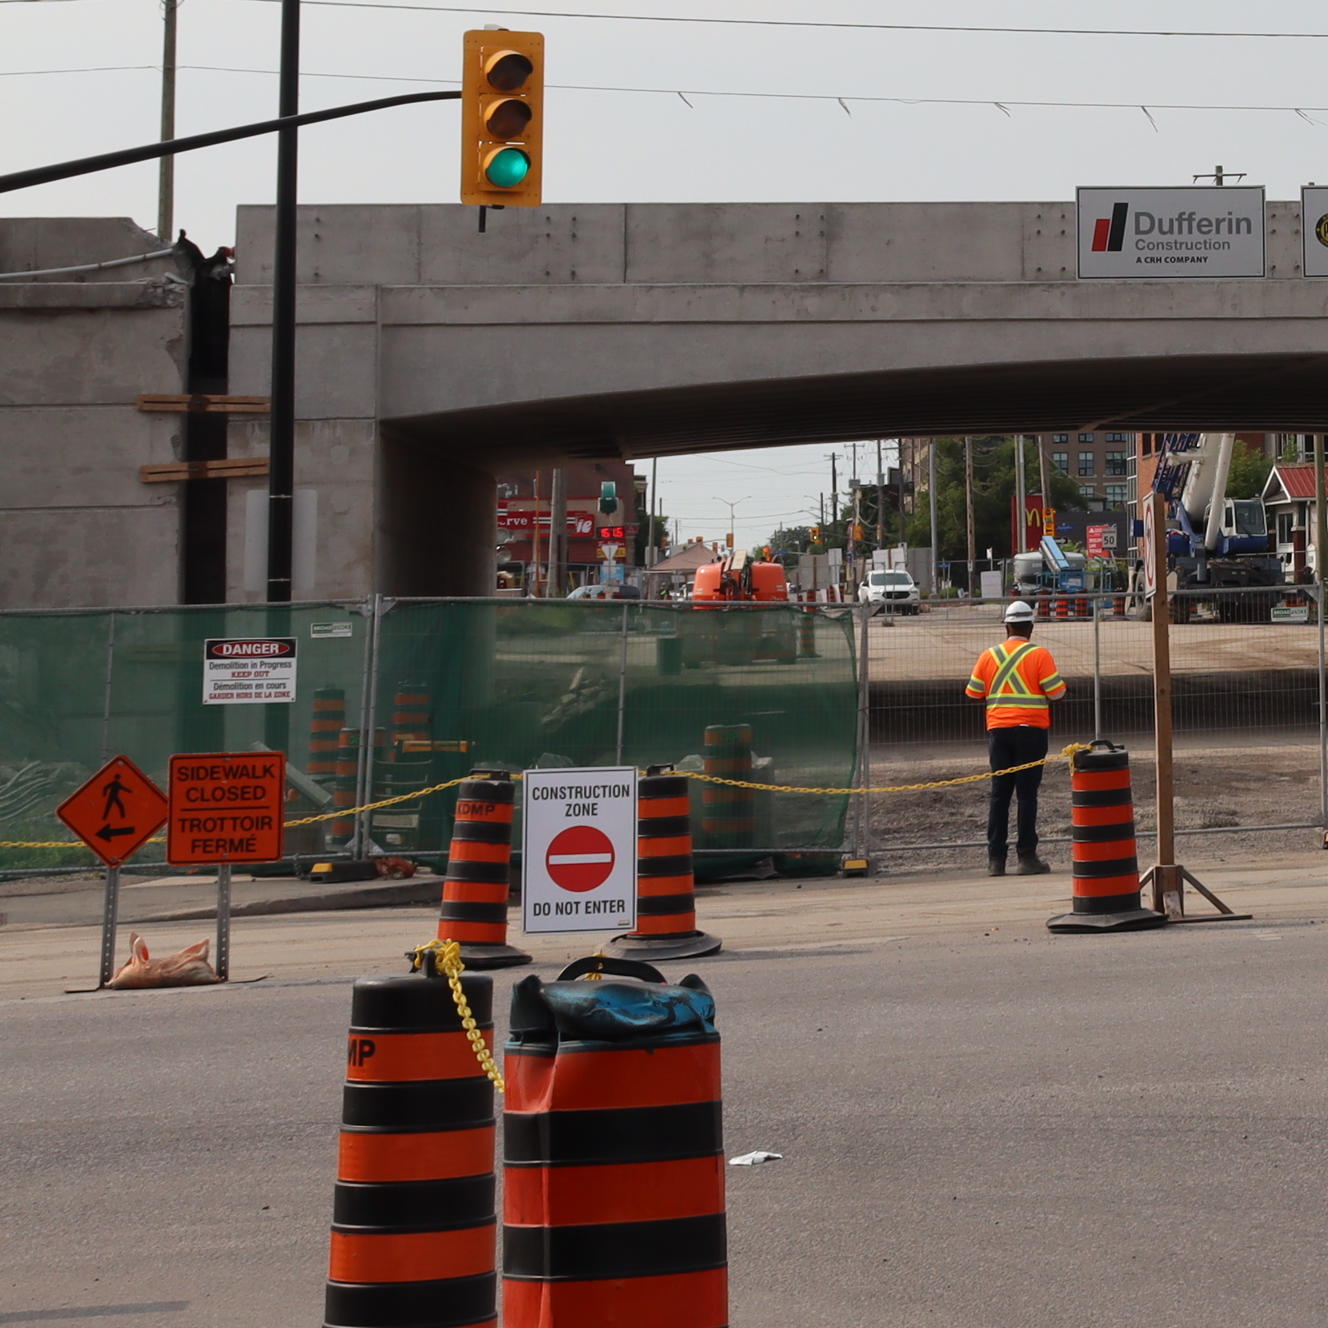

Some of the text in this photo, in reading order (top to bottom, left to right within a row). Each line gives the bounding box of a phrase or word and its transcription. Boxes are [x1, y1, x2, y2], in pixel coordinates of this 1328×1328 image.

[1134, 211, 1252, 235] Dufferin
[1135, 238, 1231, 251] Construction
[1136, 256, 1209, 264] A CRH COMPANY
[1103, 535, 1115, 546] 50
[222, 643, 280, 655] DANGER
[209, 660, 292, 670] Demolition in Progress
[266, 682, 287, 690] cours
[177, 763, 276, 782] SIDEWALK
[185, 785, 267, 802] CLOSED
[532, 784, 630, 800] CONSTRUCTION
[564, 802, 599, 817] ZONE
[178, 815, 273, 833] TROTTOIR
[191, 833, 257, 854] FERMÉ
[533, 899, 626, 916] DO NOT ENTER
